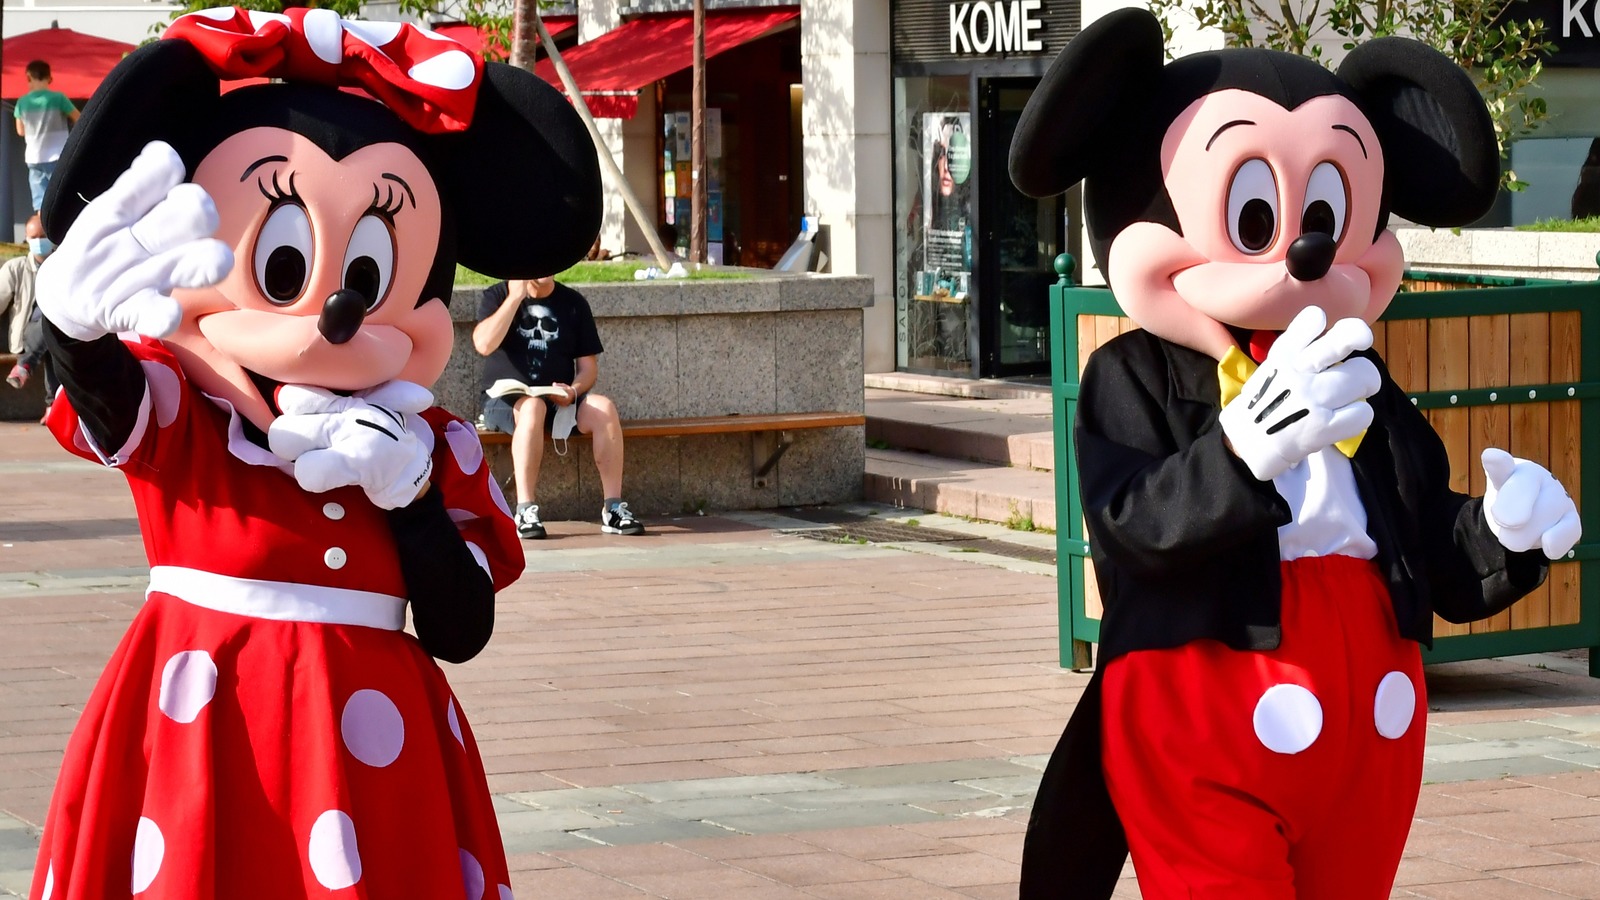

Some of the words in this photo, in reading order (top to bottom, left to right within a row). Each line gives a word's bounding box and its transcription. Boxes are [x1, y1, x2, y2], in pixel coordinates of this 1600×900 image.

[950, 1, 1042, 53] KOME
[1563, 0, 1600, 37] K
[898, 271, 906, 343] SALON
